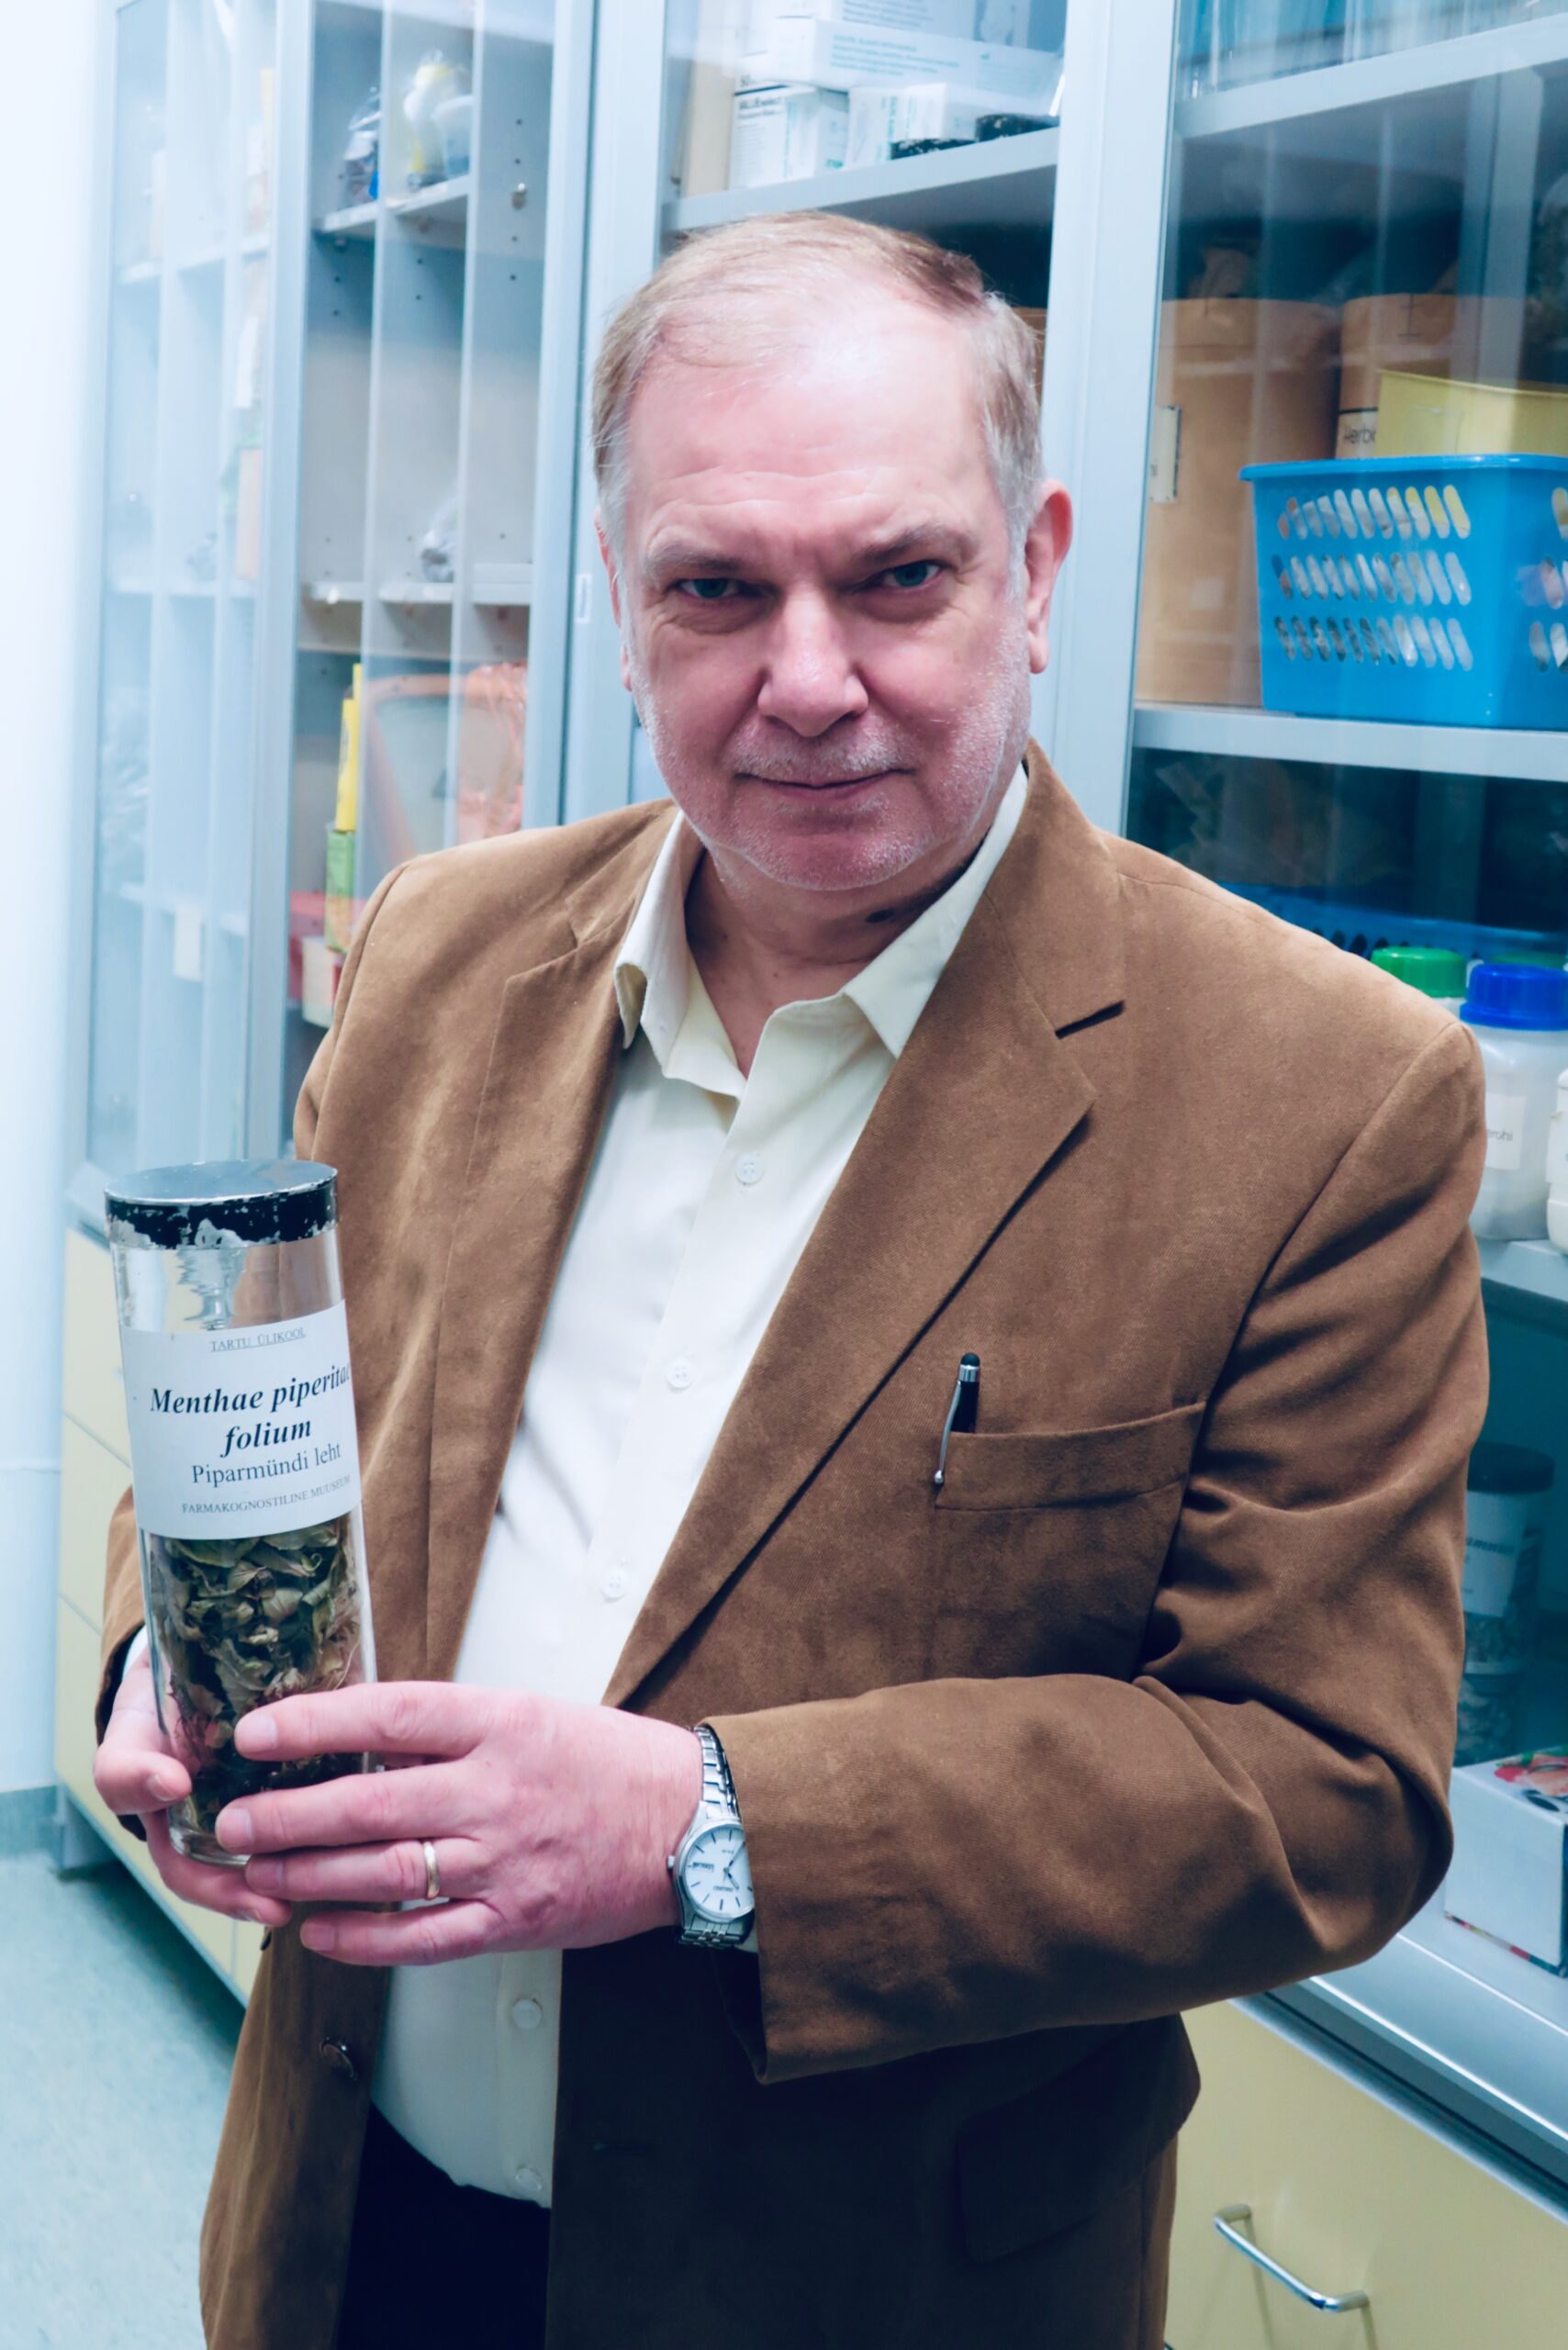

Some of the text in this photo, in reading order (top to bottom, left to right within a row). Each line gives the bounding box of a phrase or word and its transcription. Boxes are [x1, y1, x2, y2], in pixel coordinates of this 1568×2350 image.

[210, 1326, 307, 1352] TARTU ÜLIKOOL
[151, 1387, 264, 1415] Menthae
[219, 1419, 312, 1458] folium
[192, 1442, 342, 1488] Piparmündi leht
[182, 1490, 309, 1515] FARMAKOGNOSTILINE
